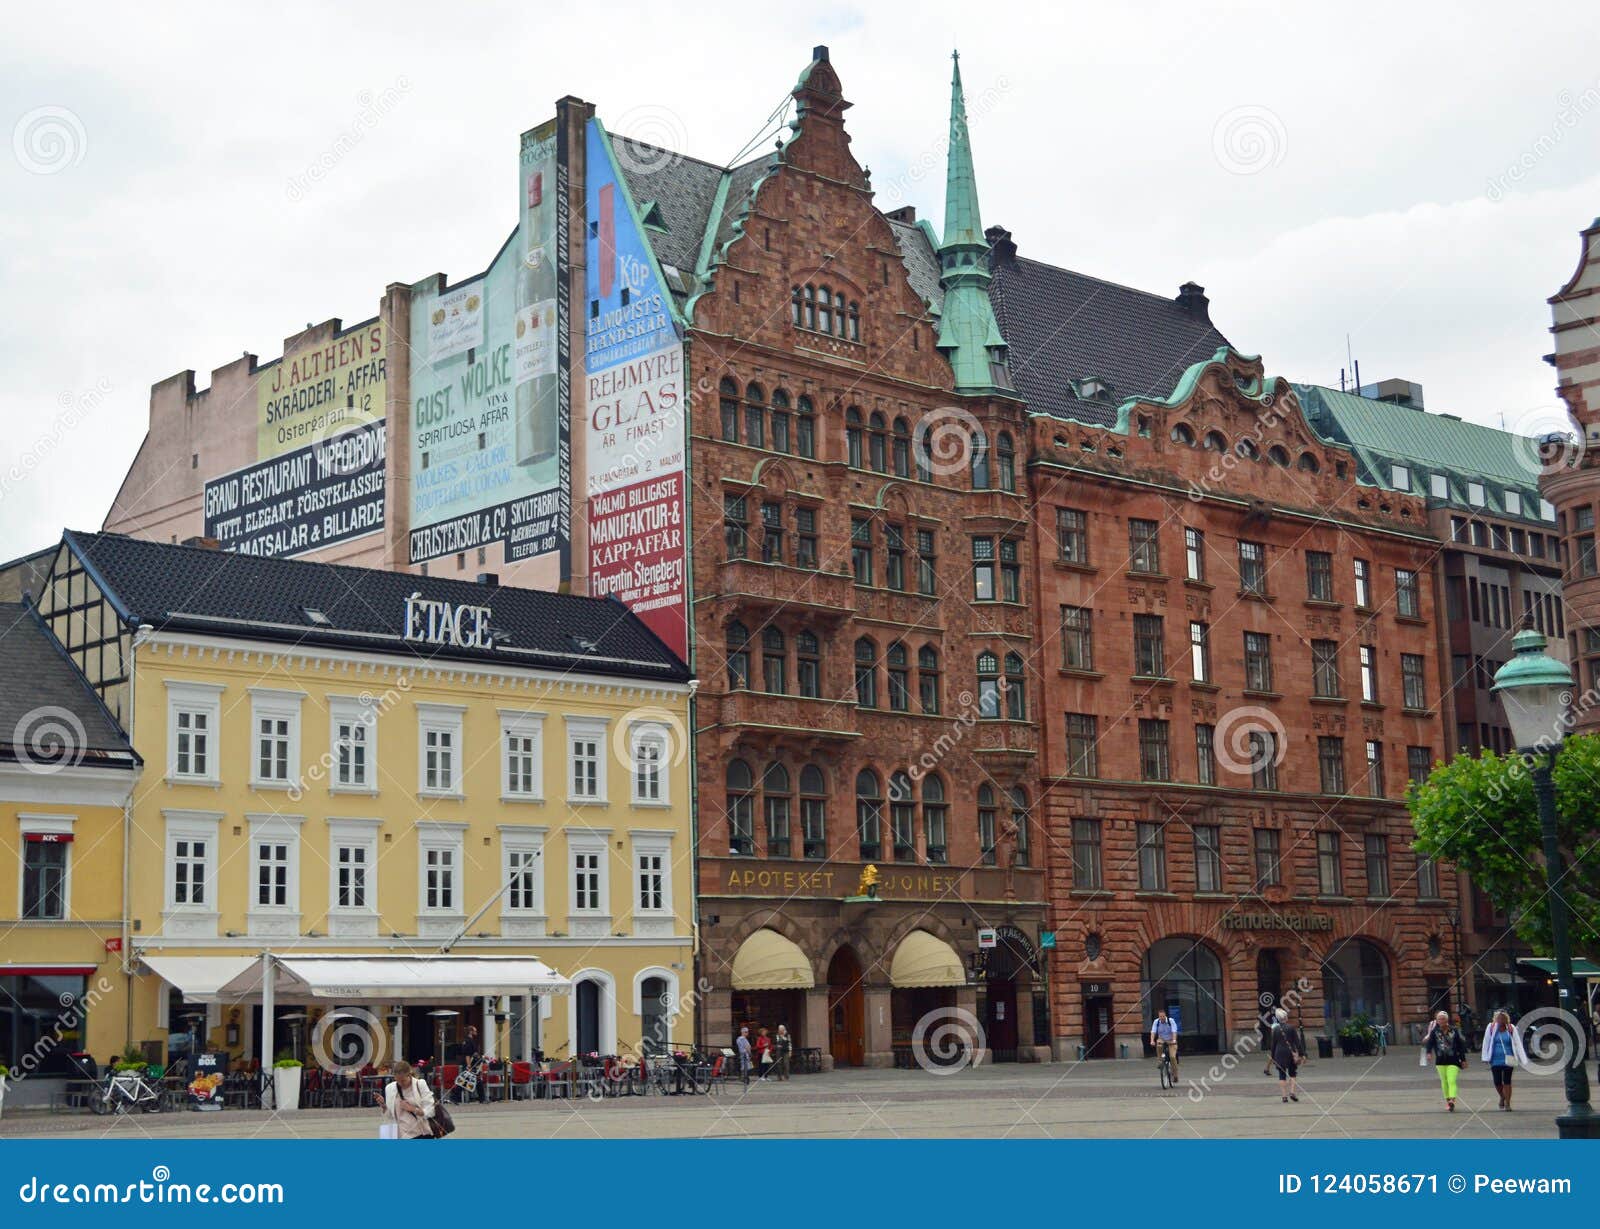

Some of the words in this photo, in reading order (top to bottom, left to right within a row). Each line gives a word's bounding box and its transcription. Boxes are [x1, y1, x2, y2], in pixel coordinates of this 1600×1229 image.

[266, 376, 336, 425] SKRÄDDERI
[347, 357, 386, 394] AFFÄR
[272, 367, 285, 392] J.
[416, 384, 455, 429] GUST.
[461, 343, 512, 404] WOLKE
[590, 350, 680, 401] REIJMYRE
[559, 365, 570, 431] GENOM
[592, 382, 678, 431] GLAS
[278, 408, 345, 445] Östergatan
[360, 394, 372, 413] 12
[418, 417, 476, 449] SPIRITUOSA
[626, 418, 664, 441] FINAST
[206, 482, 238, 519] GRAND
[242, 453, 312, 507] RESTAURANT
[317, 425, 386, 481] HIPPODROME
[646, 460, 652, 472] 2
[511, 490, 560, 525] SKYLTFABRIK
[593, 491, 626, 517] MALMÖ
[629, 478, 678, 508] BILLIGASTE
[310, 528, 321, 543] &
[410, 514, 481, 562] CHRISTENSON
[481, 514, 491, 543] &
[551, 514, 558, 531] 4
[512, 541, 539, 559] TELEFON
[592, 529, 682, 567] KAPP-AFFÄR
[593, 567, 632, 597] Florentin
[634, 556, 682, 587] Steneberg
[404, 592, 493, 649] ÉTAGE
[43, 834, 58, 842] KFC
[728, 869, 834, 889] APOTEKET
[1222, 910, 1335, 930] Handelsbanken
[1090, 984, 1099, 992] 10
